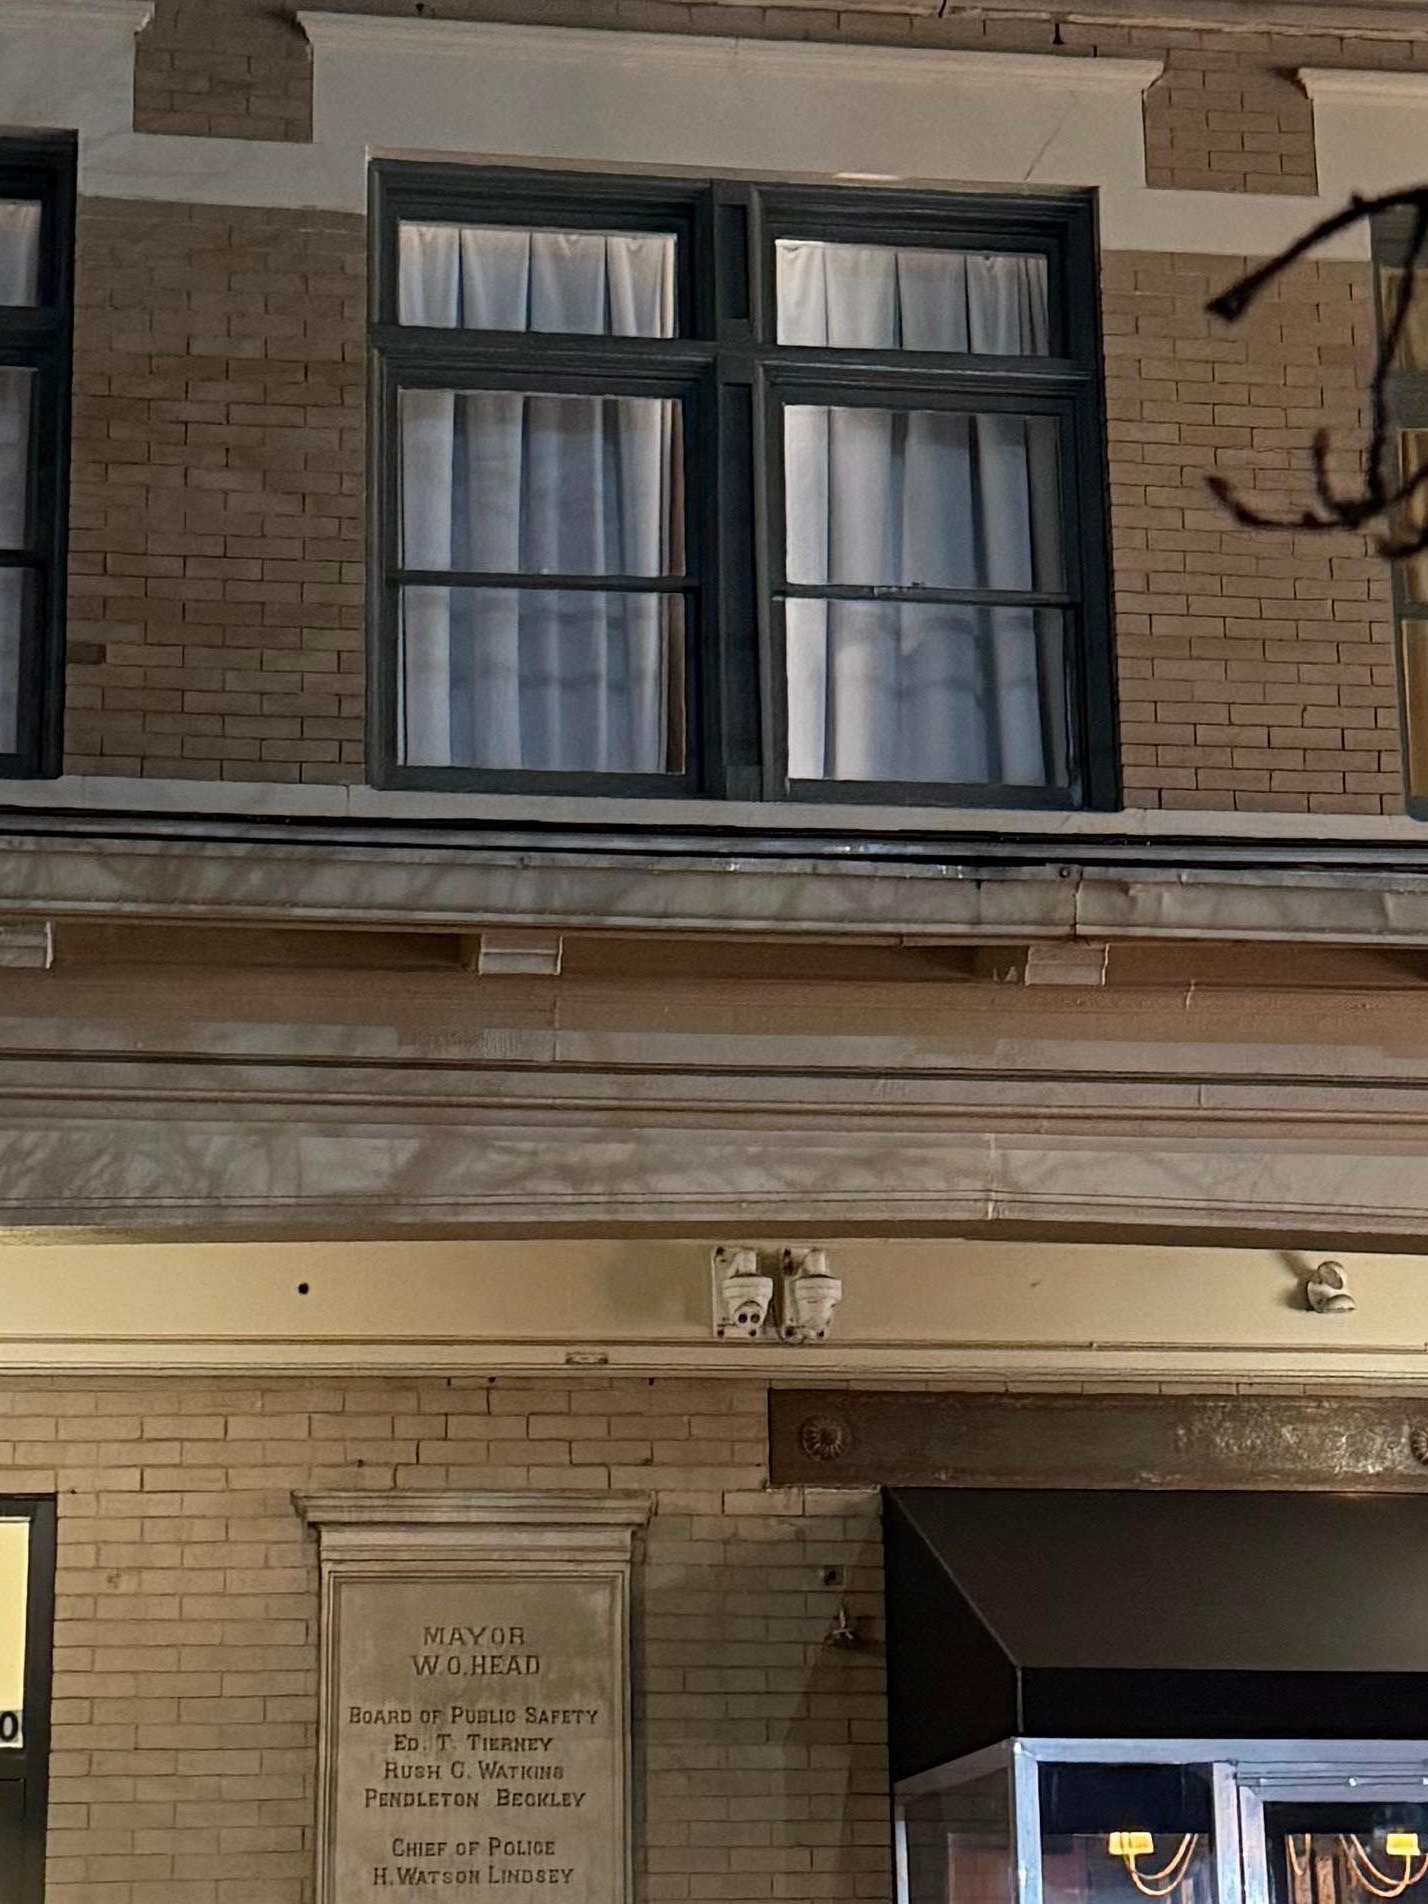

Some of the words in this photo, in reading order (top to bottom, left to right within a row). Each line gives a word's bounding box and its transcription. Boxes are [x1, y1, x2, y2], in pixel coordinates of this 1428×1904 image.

[423, 1626, 524, 1646] MAYOR
[349, 1706, 412, 1725] BOARD
[420, 1709, 444, 1724] OF
[451, 1706, 516, 1725] PUBLIC
[525, 1706, 599, 1725] SAFETY
[466, 1733, 554, 1752] TIERNEY
[384, 1760, 440, 1780] RUSH
[478, 1760, 564, 1780] WATKINS
[364, 1788, 480, 1809] PENDLETON
[495, 1788, 587, 1809] BECKLEY
[391, 1838, 448, 1857] CHIEF
[455, 1841, 480, 1856] OF
[488, 1837, 556, 1857] POLICE
[488, 1865, 574, 1885] LINDSEY
